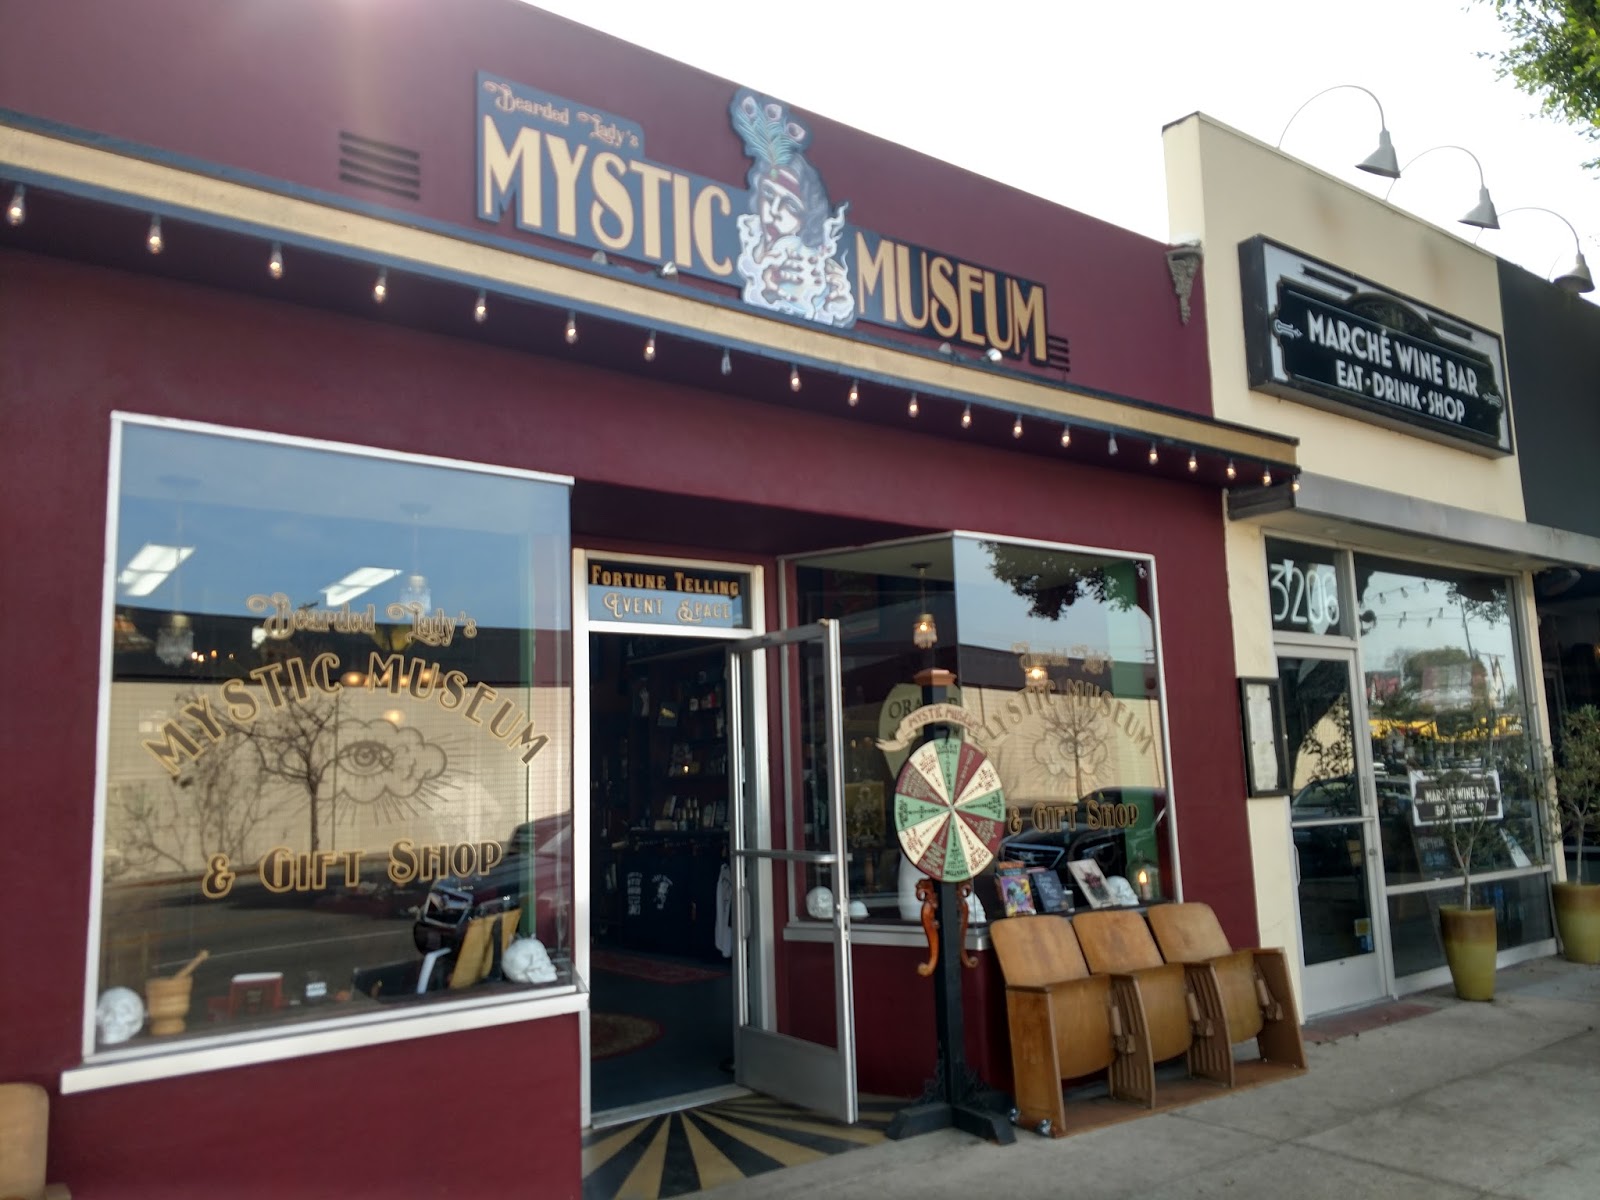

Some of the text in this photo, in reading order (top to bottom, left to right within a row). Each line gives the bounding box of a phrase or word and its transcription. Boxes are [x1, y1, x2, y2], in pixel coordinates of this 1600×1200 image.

[482, 80, 640, 148] Bearded Lady's
[482, 114, 1047, 362] MYSTIC MUSEUM
[1307, 309, 1479, 398] MARCHÉ WINE BAR
[246, 592, 478, 647] Bearded Lady's
[1270, 563, 1340, 625] 3206
[141, 651, 551, 776] MYSTIC MUSEUM
[1007, 805, 1024, 835] &
[201, 852, 236, 900] &
